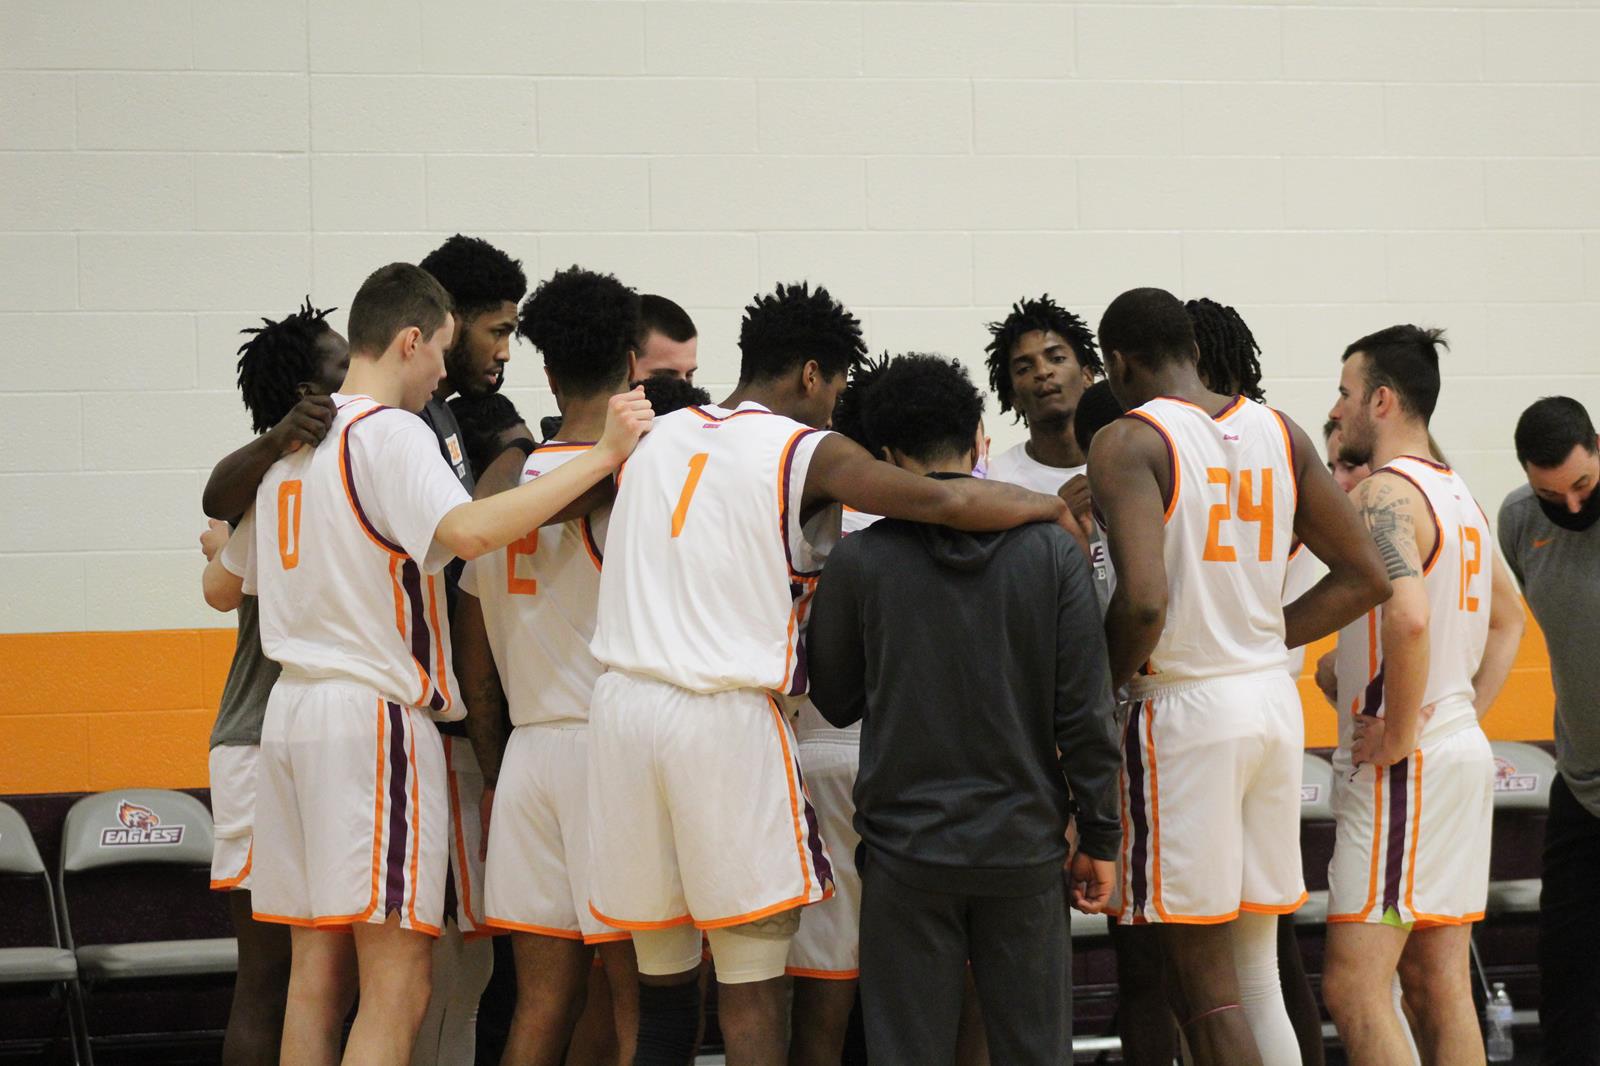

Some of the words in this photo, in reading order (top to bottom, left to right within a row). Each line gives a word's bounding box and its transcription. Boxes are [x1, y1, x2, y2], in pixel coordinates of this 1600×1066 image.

[278, 480, 303, 570] 0
[672, 454, 708, 538] 1
[1203, 468, 1274, 562] 24
[1458, 524, 1481, 613] 12
[104, 828, 180, 844] EAGLES
